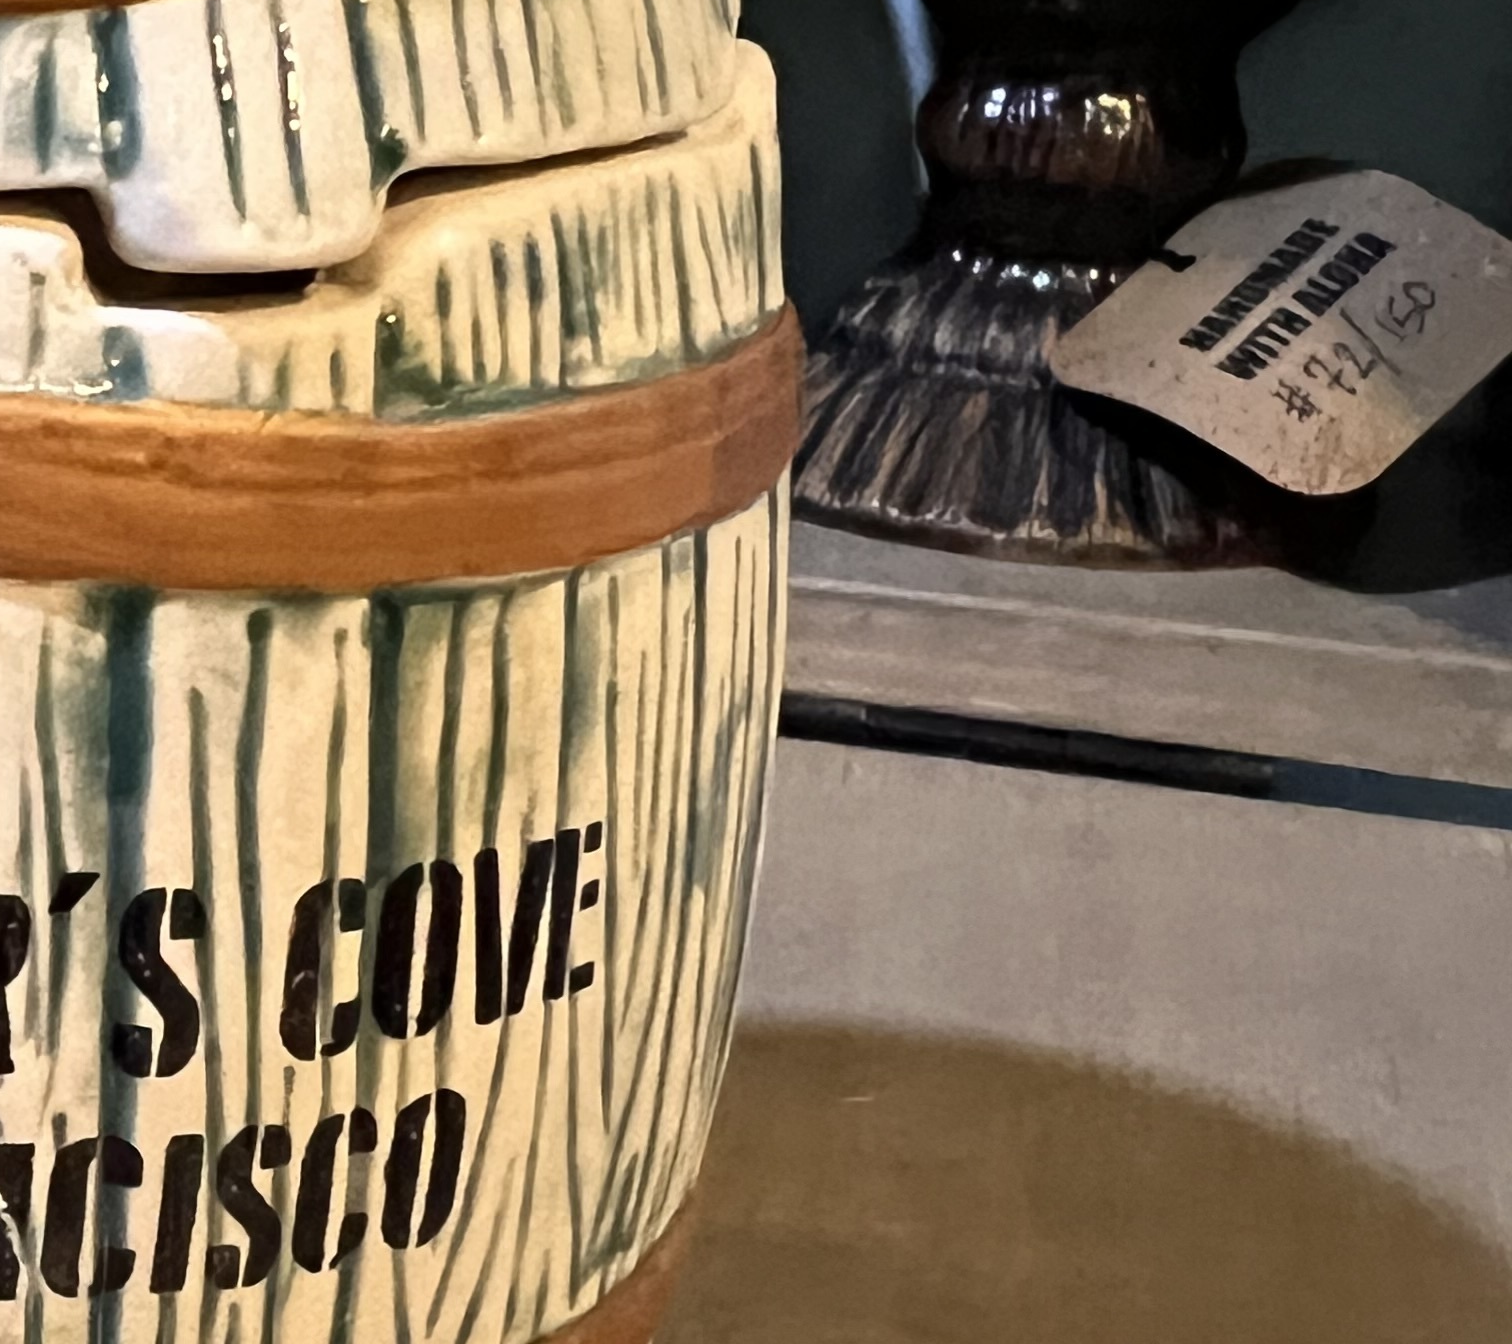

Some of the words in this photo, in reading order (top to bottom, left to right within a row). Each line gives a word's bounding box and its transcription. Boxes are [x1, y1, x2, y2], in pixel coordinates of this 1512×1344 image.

[1179, 218, 1340, 352] HANDMADE
[1214, 307, 1313, 380] WITH
[1292, 232, 1398, 317] ALOHA
[279, 821, 604, 1062] COVE
